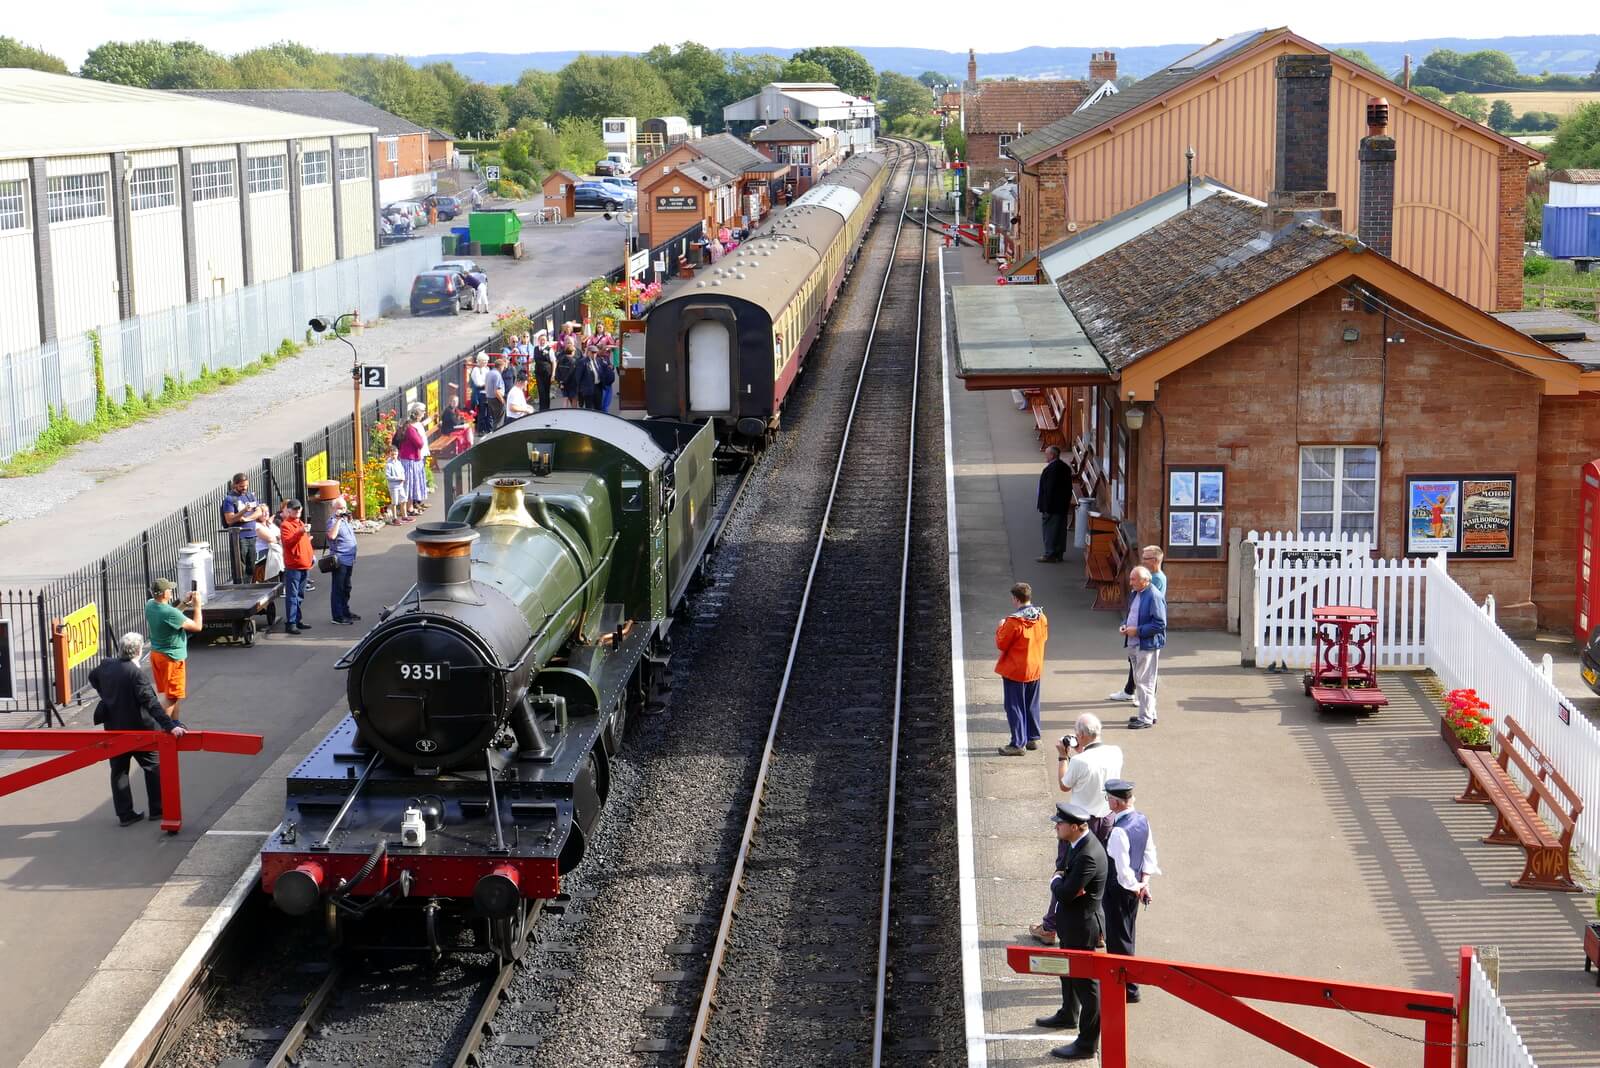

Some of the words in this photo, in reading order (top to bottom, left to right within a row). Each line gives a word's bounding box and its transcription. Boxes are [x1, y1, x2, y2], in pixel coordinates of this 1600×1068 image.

[368, 369, 380, 385] 2
[1100, 583, 1121, 601] GWR
[400, 664, 441, 680] 9351
[1532, 849, 1564, 875] GWR
